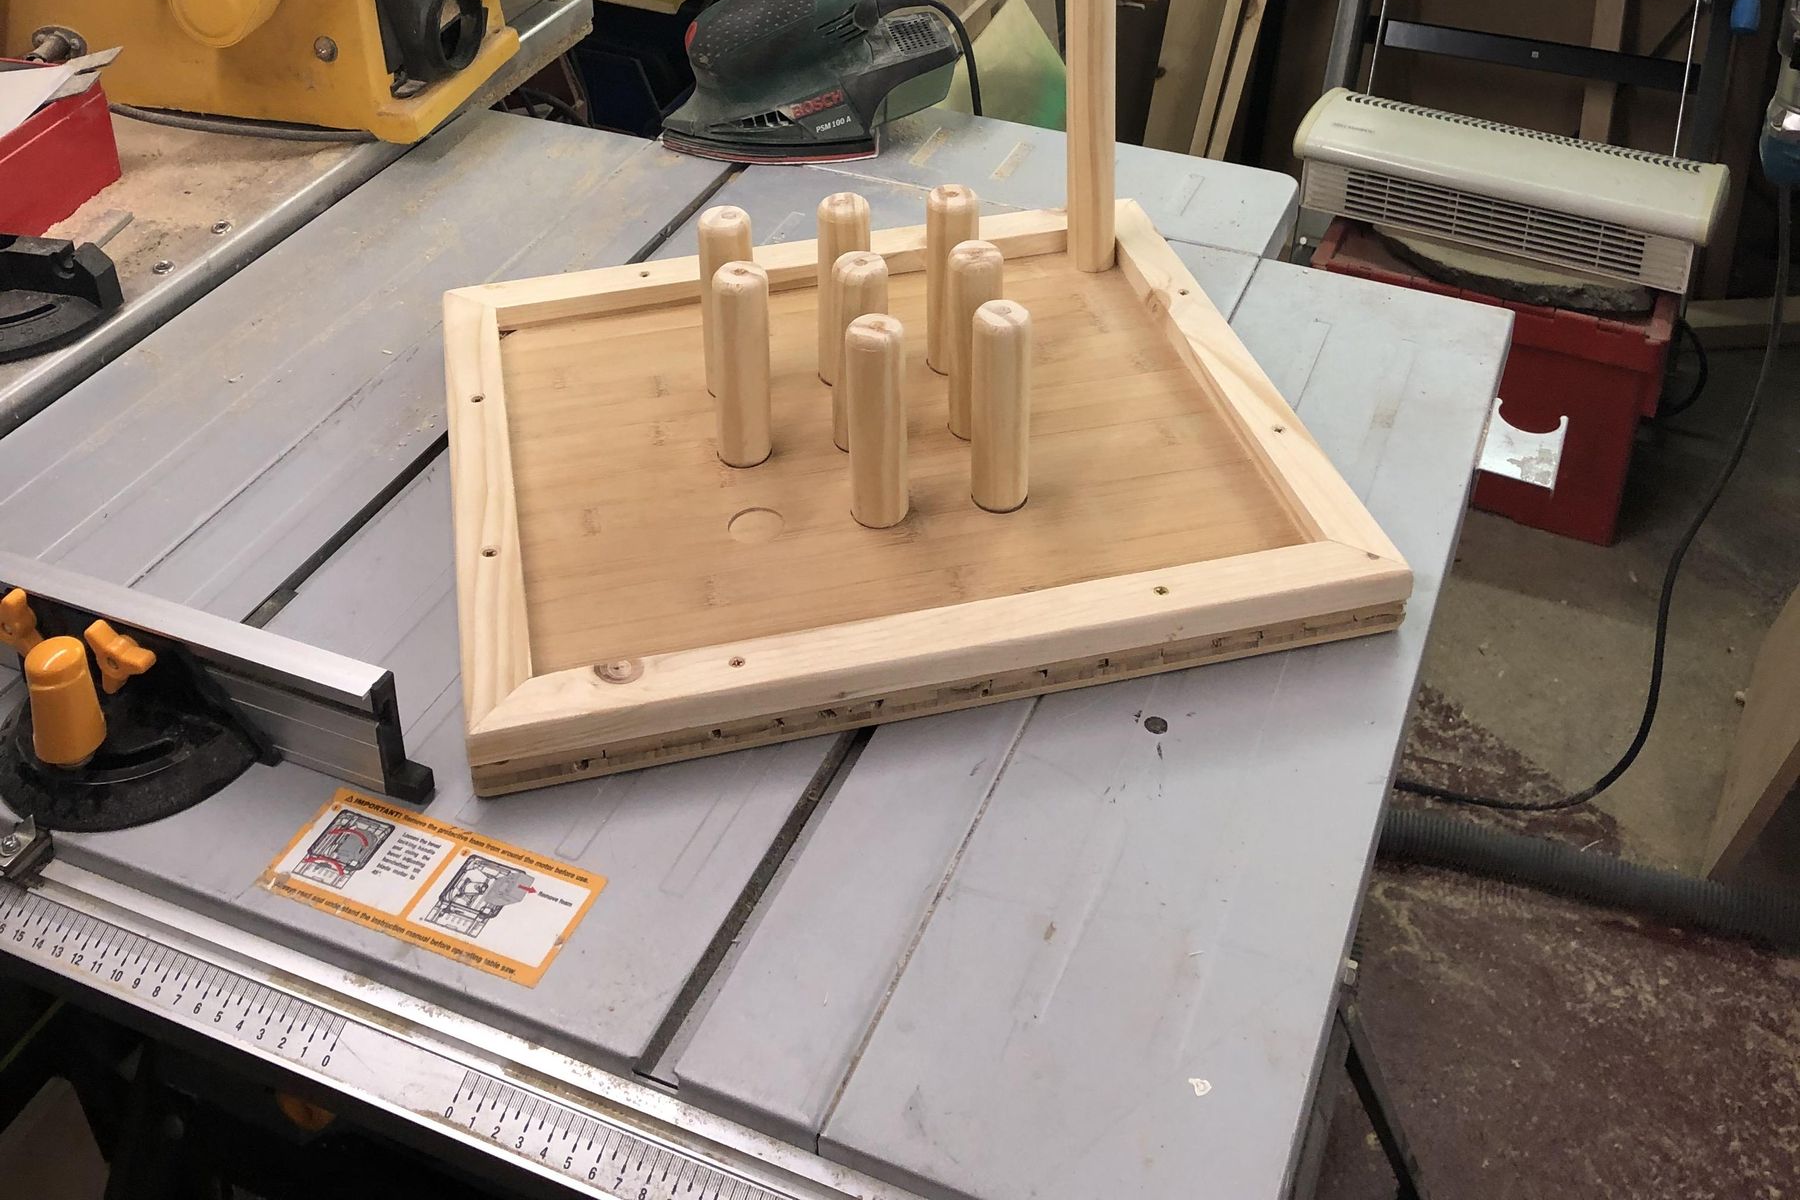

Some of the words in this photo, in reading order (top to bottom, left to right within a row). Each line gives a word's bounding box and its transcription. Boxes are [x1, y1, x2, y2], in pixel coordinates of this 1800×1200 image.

[791, 89, 844, 119] BOSCH
[816, 122, 832, 133] PSM
[832, 117, 845, 128] 100
[846, 115, 852, 123] A
[352, 797, 403, 818] IMPORTANT!
[402, 814, 428, 827] Remove
[436, 826, 469, 841] protective
[500, 848, 523, 859] around
[522, 856, 535, 864] the
[534, 860, 554, 871] motor
[553, 867, 576, 878] before
[575, 874, 590, 883] use.
[537, 890, 559, 902] Remove
[323, 899, 360, 916] undestand
[358, 912, 371, 920] the
[404, 929, 430, 942] manual
[429, 937, 452, 950] before
[0, 923, 6, 934] 6
[13, 929, 25, 941] 15
[32, 937, 44, 950] 14
[51, 945, 64, 958] 13
[70, 953, 84, 966] 12
[90, 960, 102, 973] 11
[110, 969, 123, 982] 10
[132, 978, 140, 989] 9
[152, 986, 161, 997] 8
[173, 994, 182, 1005] 7
[193, 1003, 202, 1014] 6
[214, 1011, 223, 1022] 5
[236, 1020, 244, 1031] 4
[256, 1028, 265, 1040] 3
[277, 1037, 287, 1049] 2
[301, 1046, 308, 1057] 1
[322, 1055, 330, 1067] 0
[445, 1106, 453, 1118] 0
[469, 1117, 476, 1128] 1
[491, 1126, 500, 1139] 2
[515, 1136, 524, 1148] 3
[540, 1147, 548, 1159] 4
[564, 1157, 572, 1169] 5
[588, 1167, 597, 1180] 6
[614, 1177, 623, 1190] 7
[638, 1188, 647, 1200] 8
